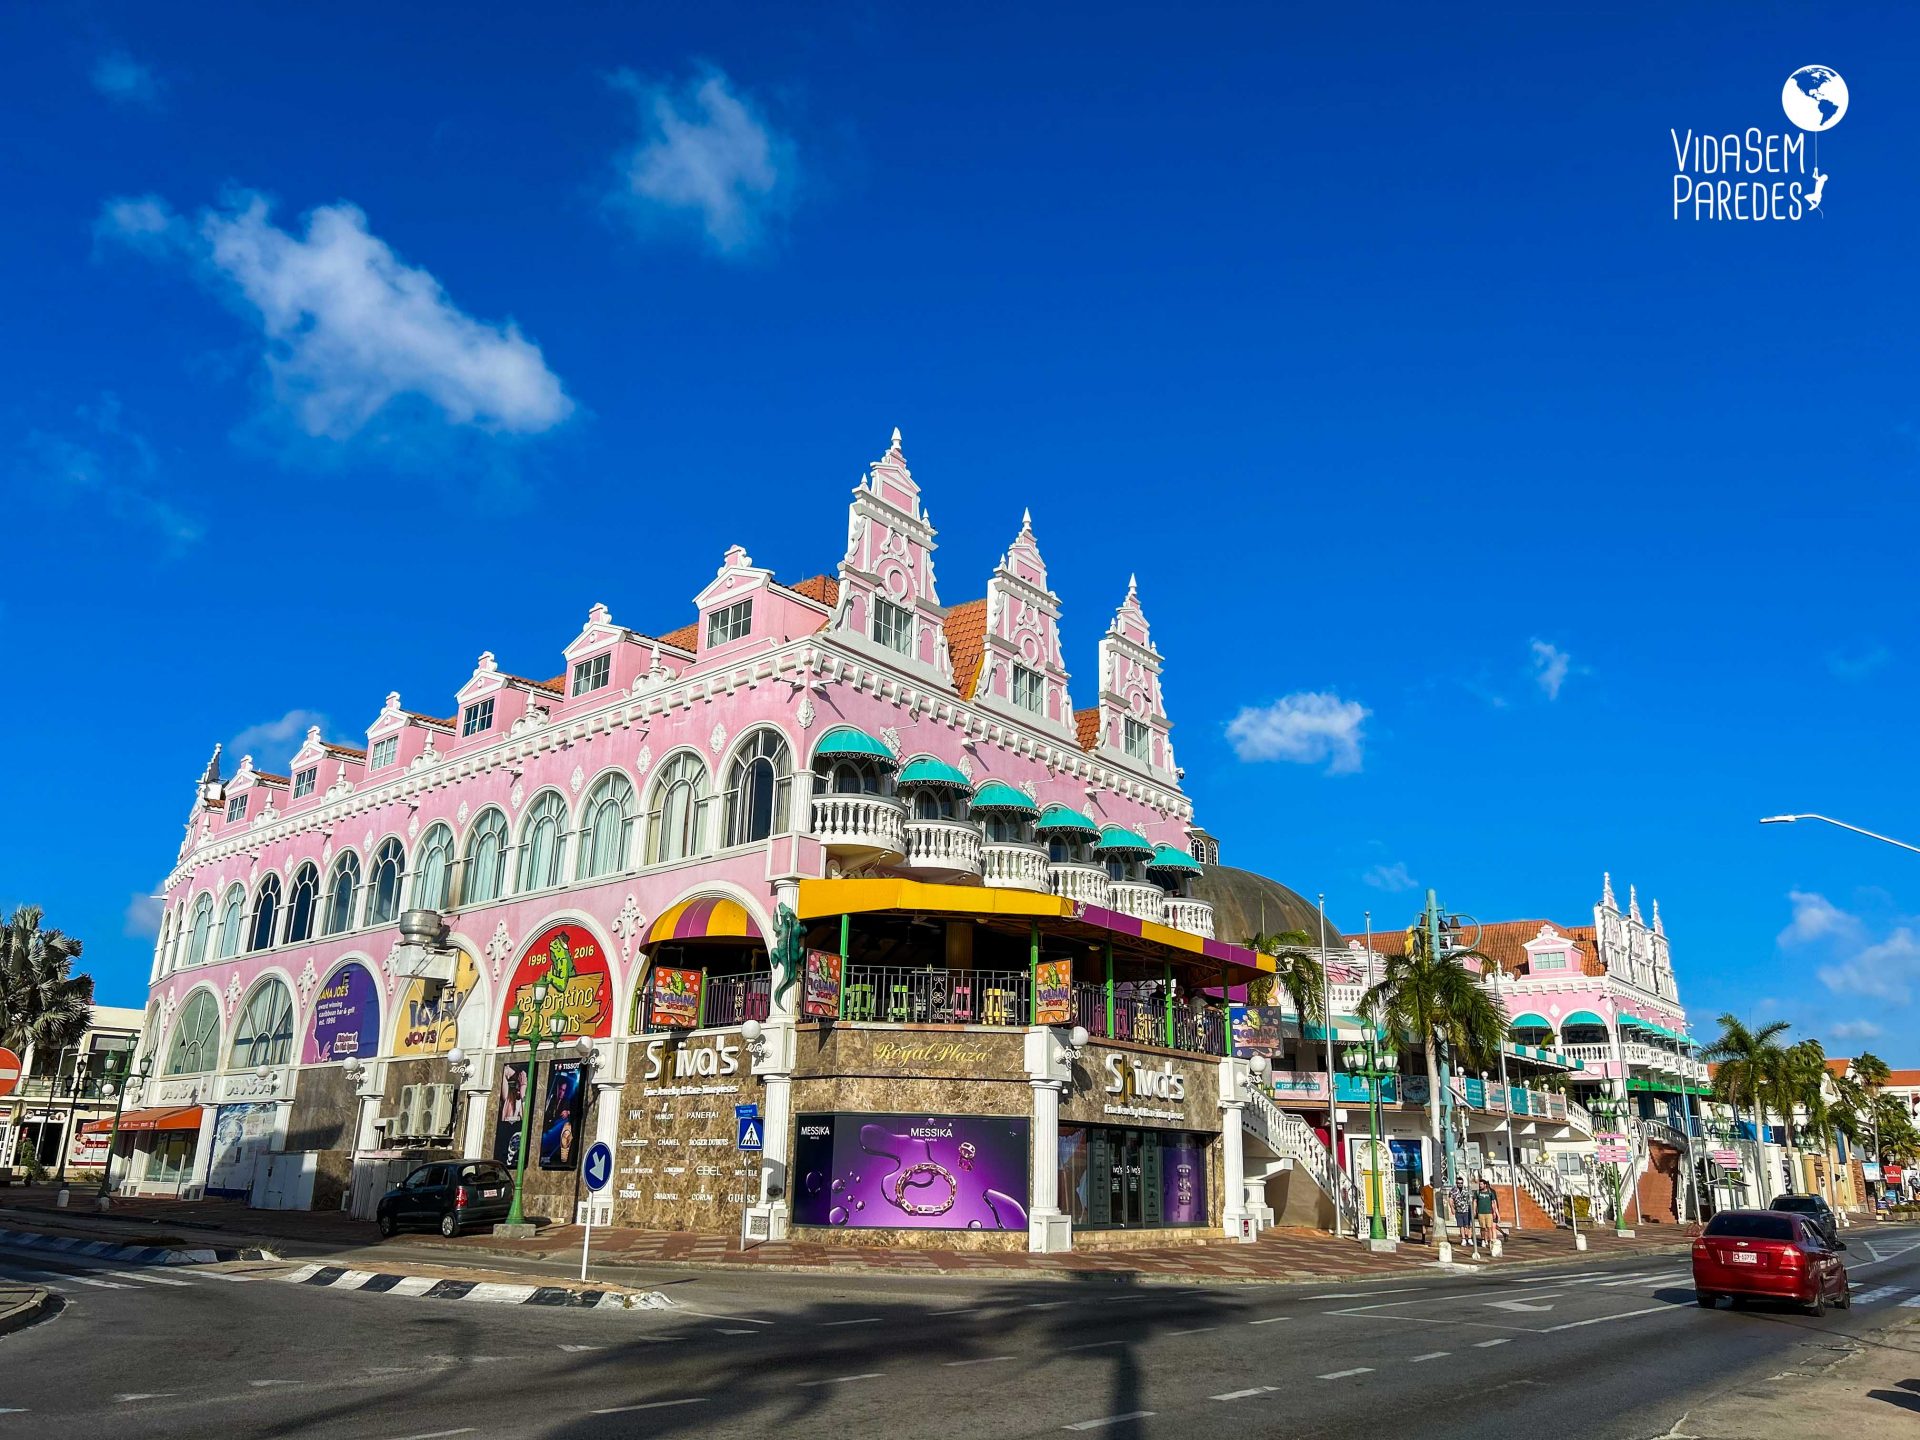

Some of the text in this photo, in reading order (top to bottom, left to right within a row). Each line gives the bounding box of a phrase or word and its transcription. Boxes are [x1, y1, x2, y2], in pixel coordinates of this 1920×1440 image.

[574, 945, 594, 959] 2016
[528, 953, 547, 967] 1996
[876, 1041, 988, 1068] Royal Plaza
[563, 1062, 580, 1070] TISSOT
[644, 1035, 739, 1086] Shiva's
[1105, 1053, 1184, 1103] Shiva's
[629, 1110, 644, 1120] IWC
[801, 1126, 830, 1136] MESSIKA
[910, 1127, 953, 1138] MESSIKA
[1356, 1141, 1390, 1161] DIREORY
[696, 1165, 723, 1176] EBEL
[735, 1169, 758, 1177] MICELE
[619, 1190, 642, 1199] TISSOT
[691, 1193, 713, 1201] CORUM
